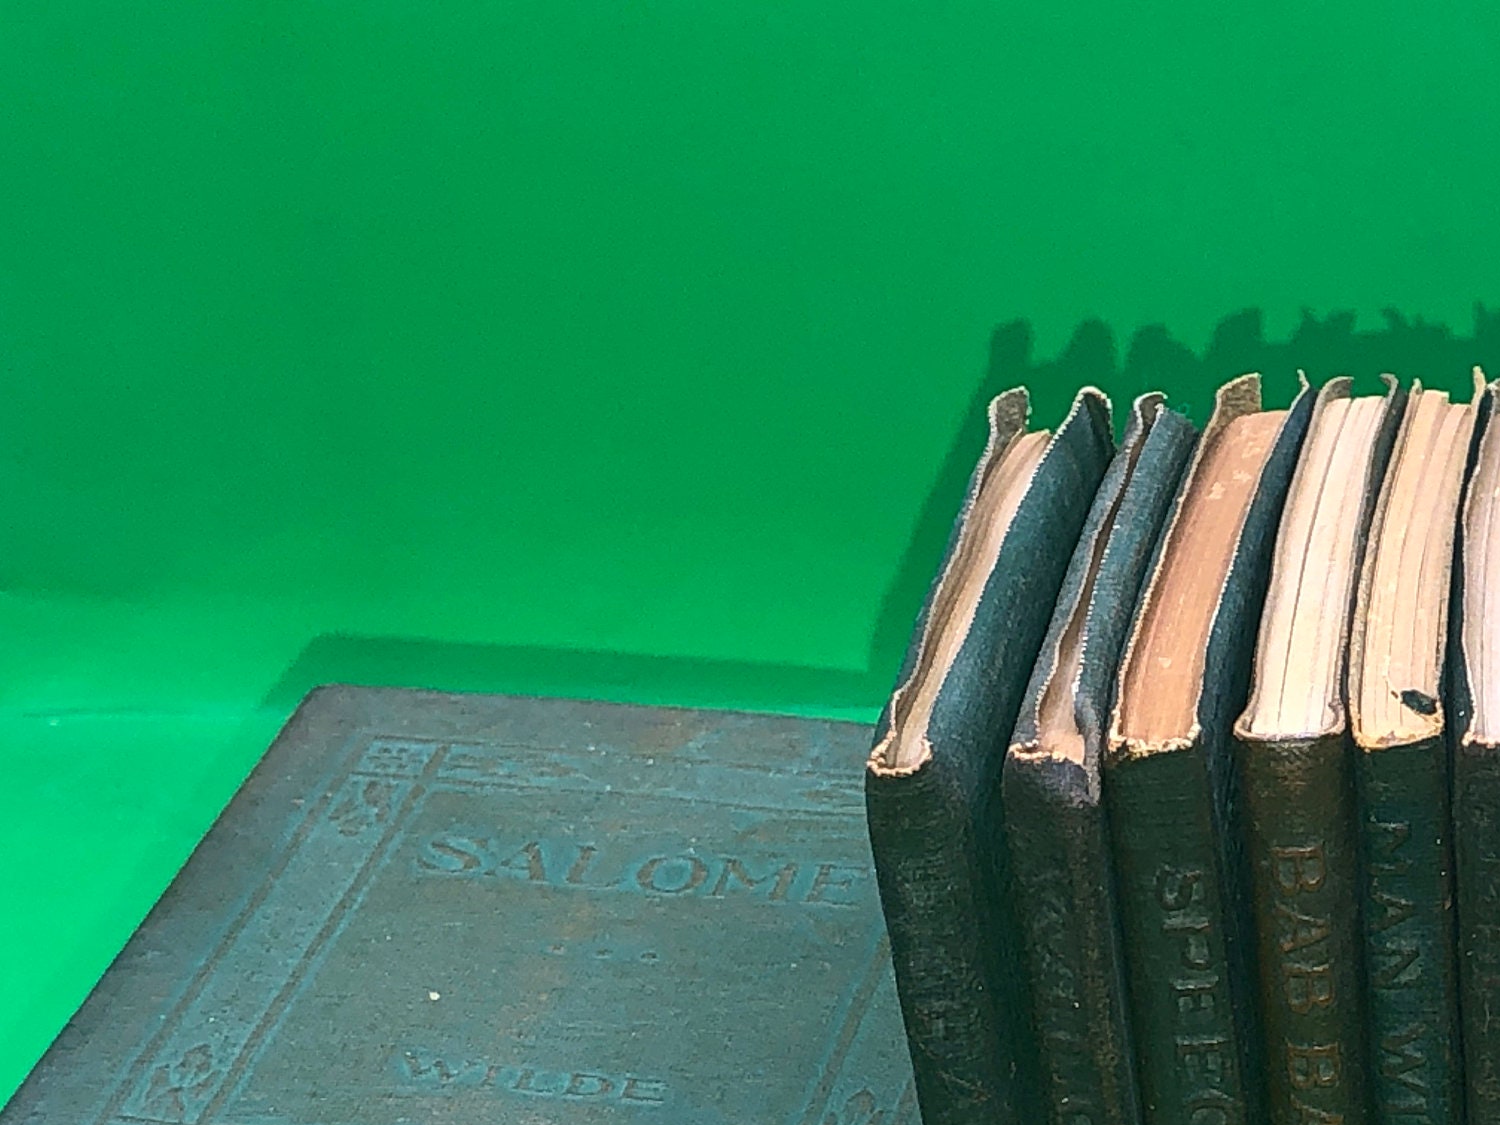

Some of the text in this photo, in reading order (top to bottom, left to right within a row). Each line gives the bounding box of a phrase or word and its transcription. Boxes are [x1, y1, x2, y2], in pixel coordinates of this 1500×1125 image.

[416, 835, 872, 909] SALOME
[1269, 843, 1337, 1014] BAB
[1365, 818, 1424, 994] MAN
[399, 1048, 672, 1104] WILDE
